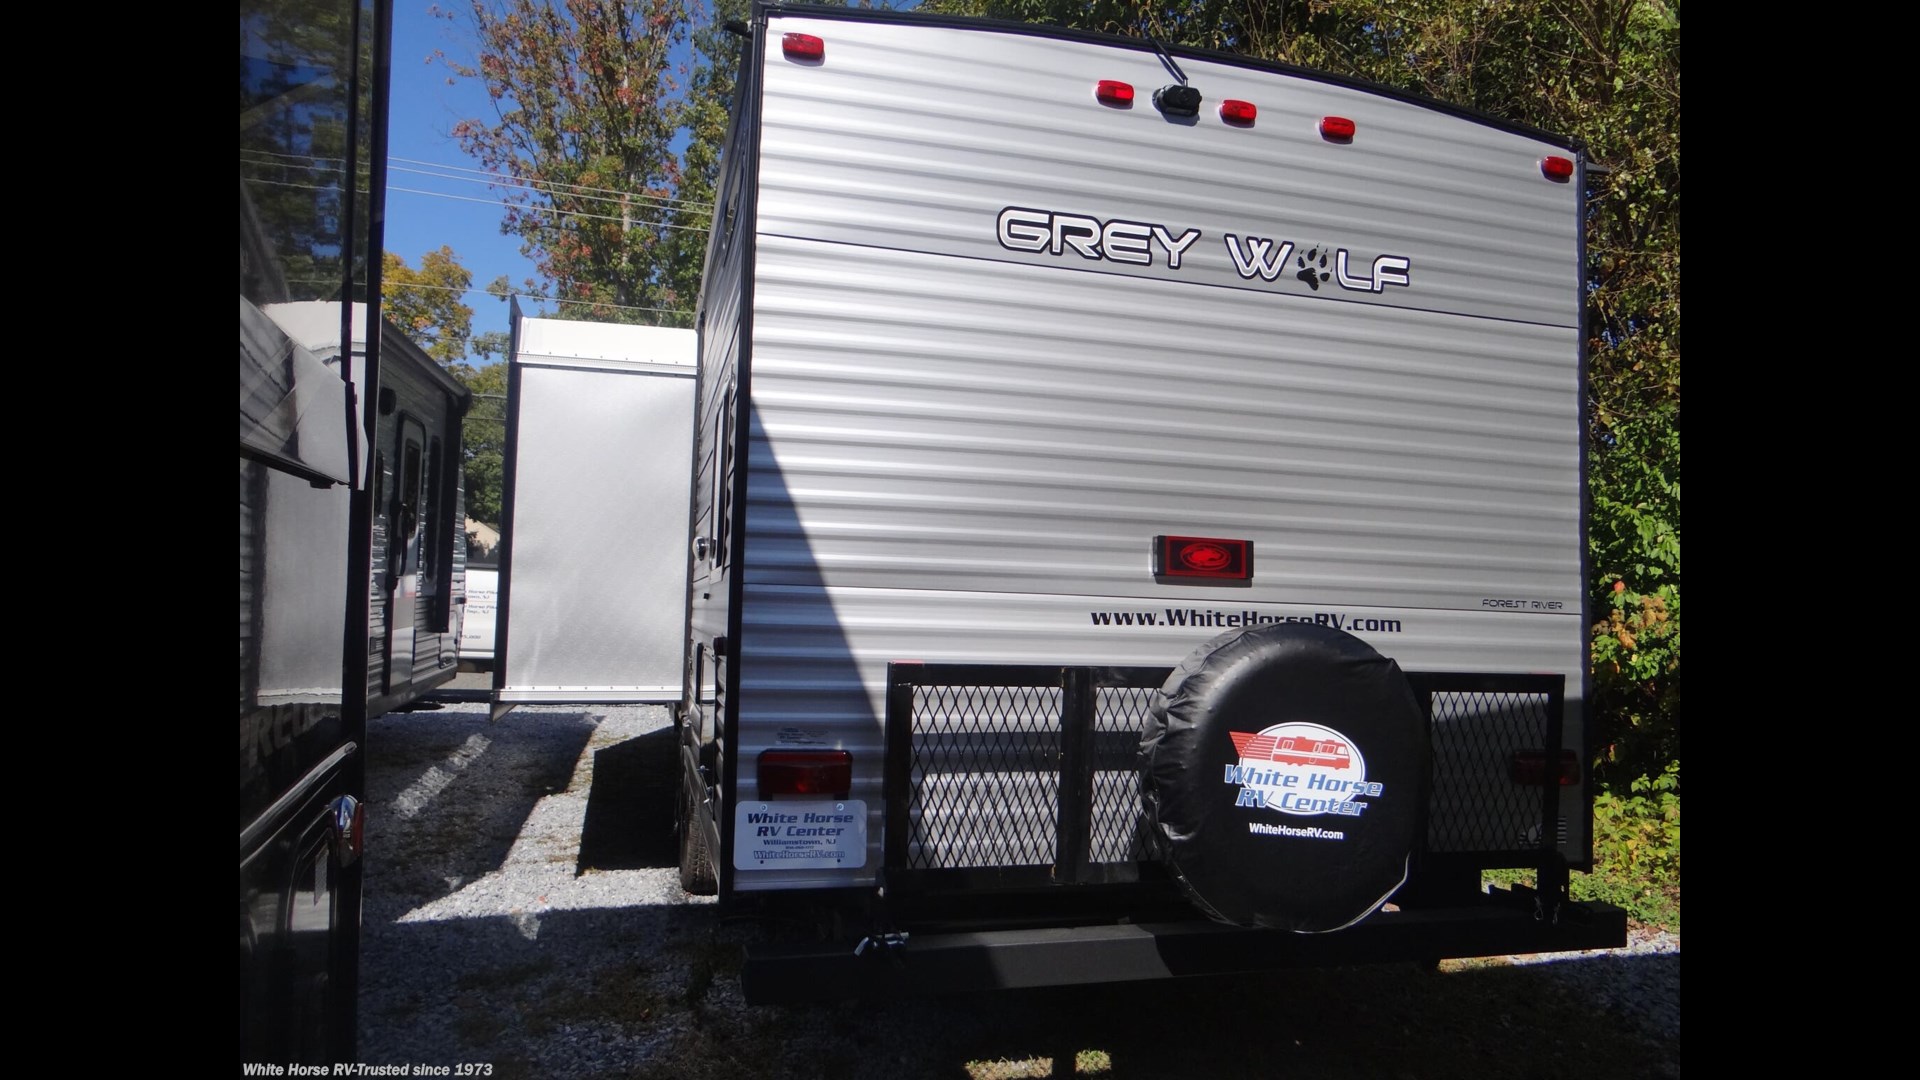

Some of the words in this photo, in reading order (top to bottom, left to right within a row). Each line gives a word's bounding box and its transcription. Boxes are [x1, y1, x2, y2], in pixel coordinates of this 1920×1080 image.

[997, 206, 1201, 268] GREY
[1224, 234, 1410, 293] WLF
[1482, 599, 1527, 608] FOREST
[1531, 601, 1563, 610] RIVER
[1224, 764, 1299, 788] White
[1307, 773, 1384, 797] Horse
[1235, 788, 1274, 808] RV
[1281, 792, 1368, 817] Center
[748, 813, 798, 824] White
[803, 813, 854, 824] Horse
[757, 826, 781, 837] RV
[786, 826, 845, 836] Center
[1249, 823, 1344, 840] WhiteHorseRV.com
[754, 850, 845, 859] WhiteHorseRV.com
